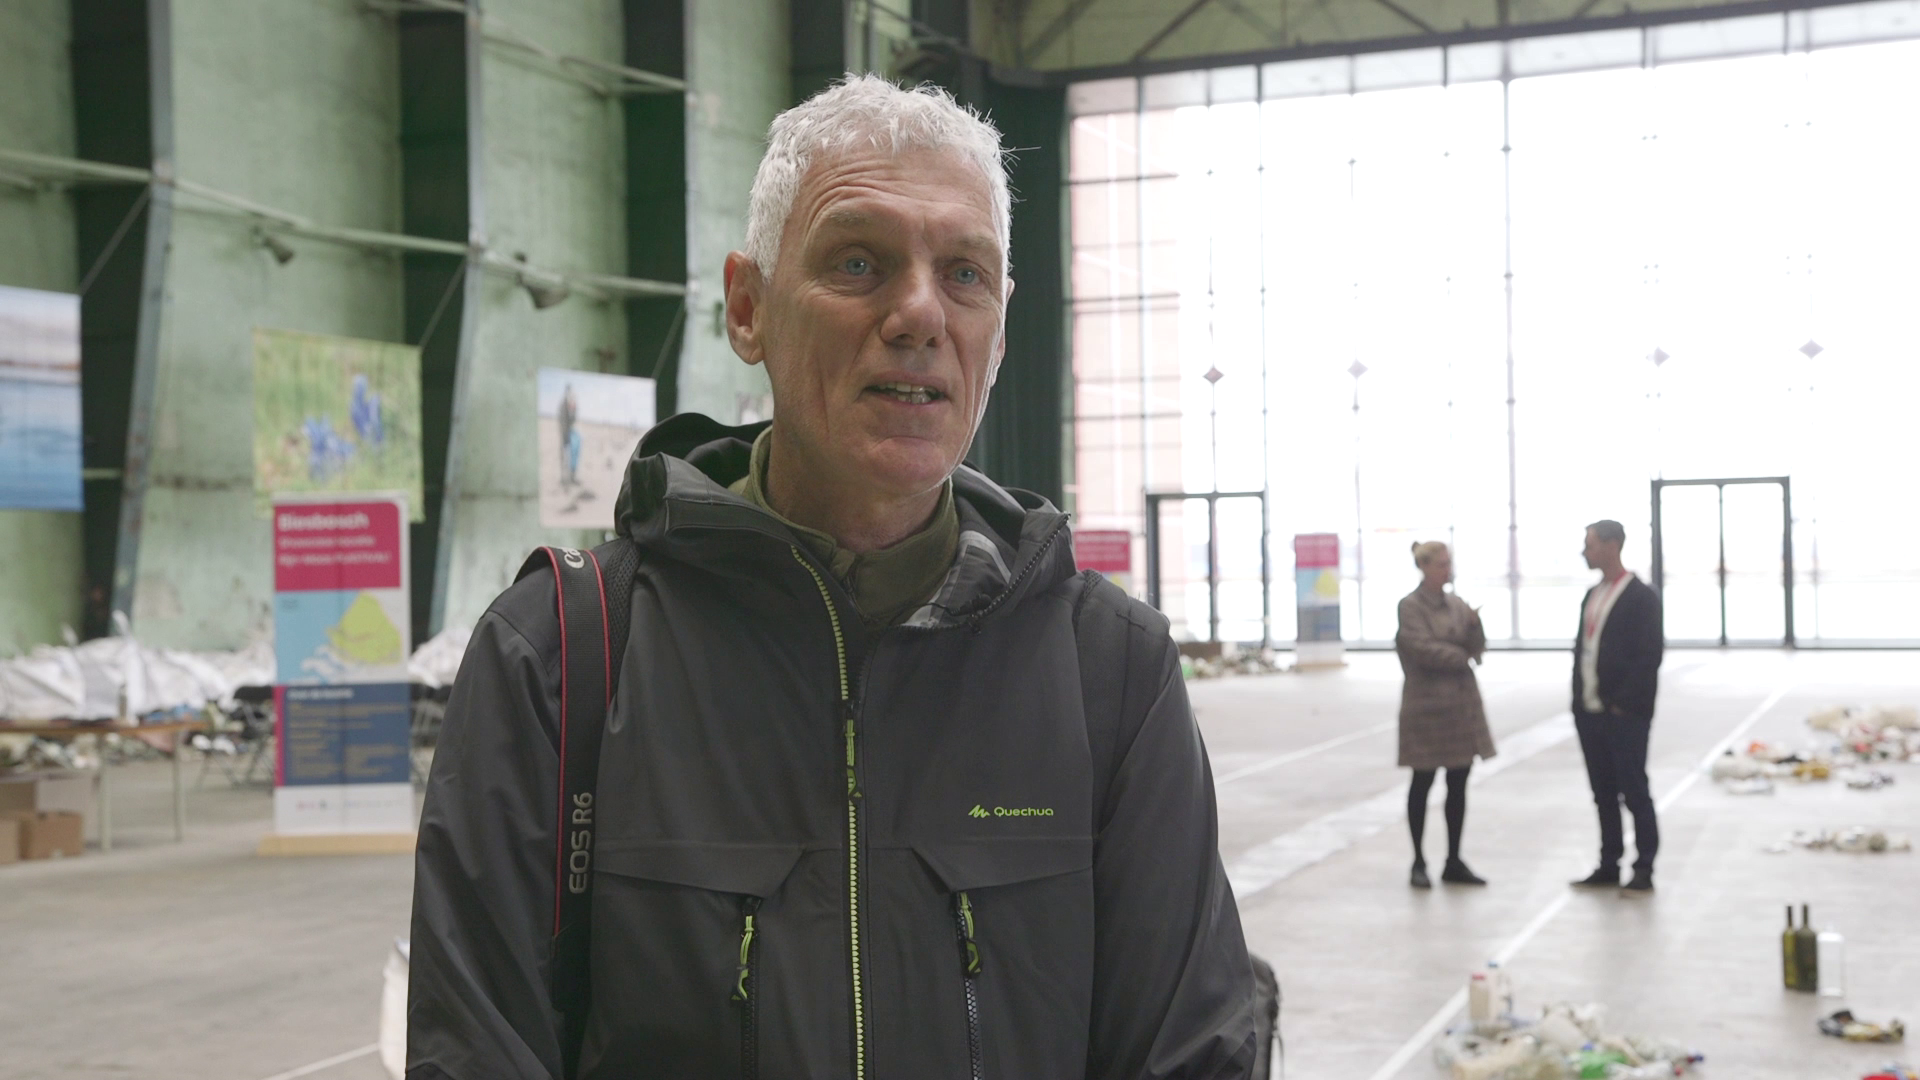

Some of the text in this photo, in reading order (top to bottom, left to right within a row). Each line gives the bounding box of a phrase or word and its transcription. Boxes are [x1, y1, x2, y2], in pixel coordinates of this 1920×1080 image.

[993, 805, 1054, 818] Quechua
[569, 792, 592, 894] EOS R6
